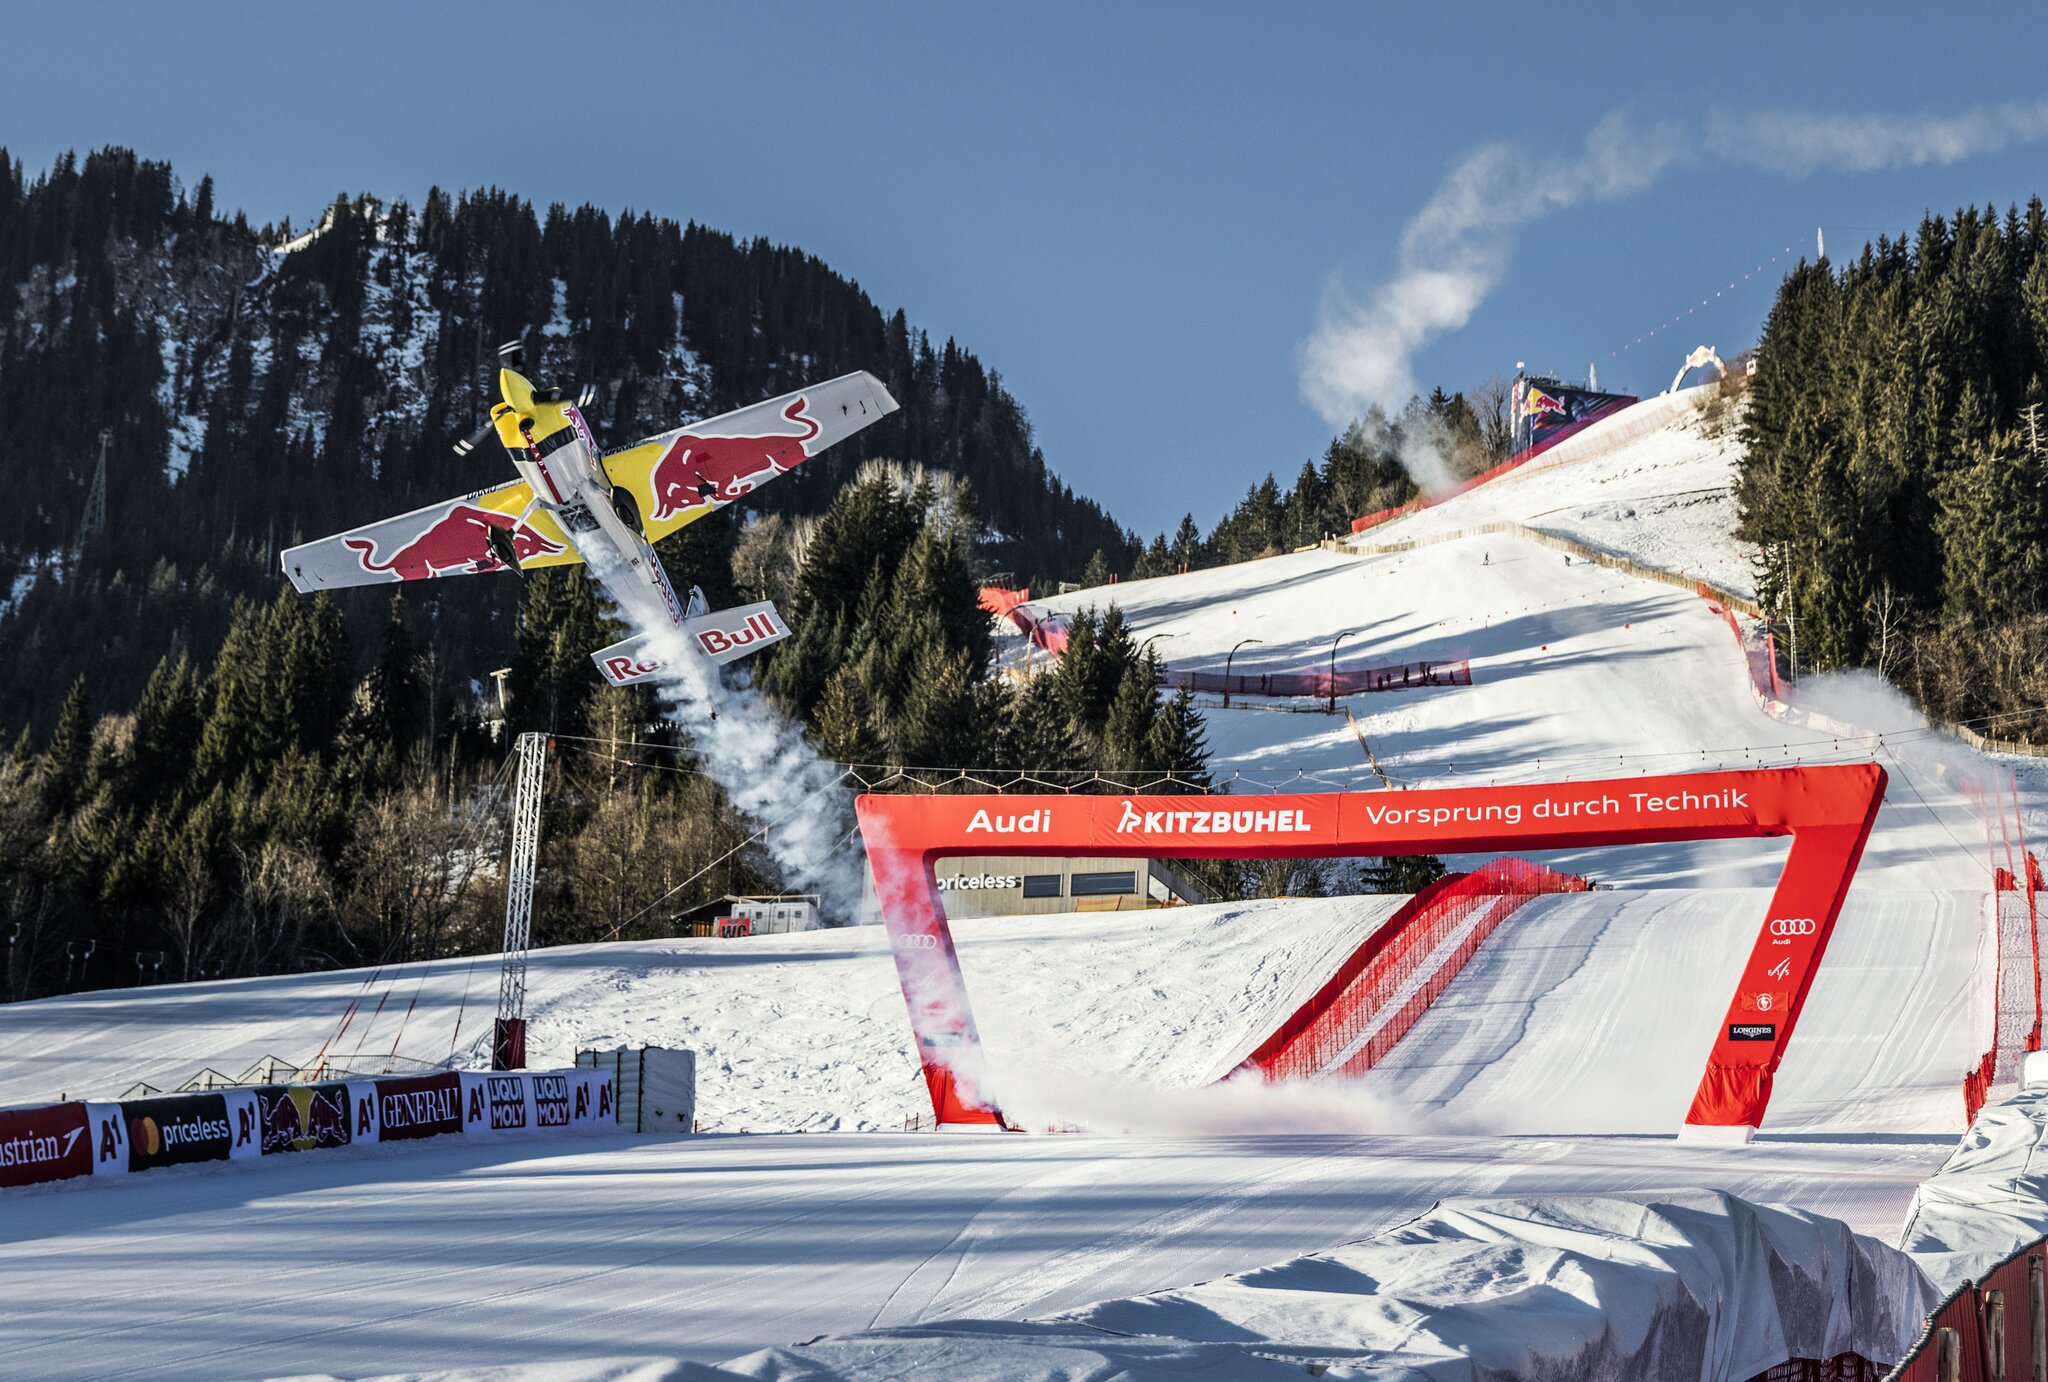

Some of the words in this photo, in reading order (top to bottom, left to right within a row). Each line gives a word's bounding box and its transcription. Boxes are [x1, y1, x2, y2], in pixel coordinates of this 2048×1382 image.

[526, 434, 548, 474] PRADA
[606, 656, 674, 680] Re
[698, 612, 778, 655] Bull
[965, 809, 1051, 833] Audi
[1365, 804, 1522, 828] Vorsprung
[1533, 794, 1620, 819] durch
[1629, 787, 1749, 814] Technik
[721, 924, 747, 938] WC
[382, 1087, 459, 1128] GENERALI
[468, 1083, 485, 1123] A1
[489, 1079, 523, 1101] LIQUI
[533, 1078, 567, 1100] LIQUI
[575, 1081, 590, 1119] A1
[599, 1079, 613, 1118] A1
[236, 1101, 255, 1147] A1
[357, 1093, 374, 1136] A1
[491, 1103, 525, 1127] MOLY
[537, 1102, 568, 1125] MOLY
[100, 1114, 122, 1163] A1
[163, 1116, 229, 1151] priceless
